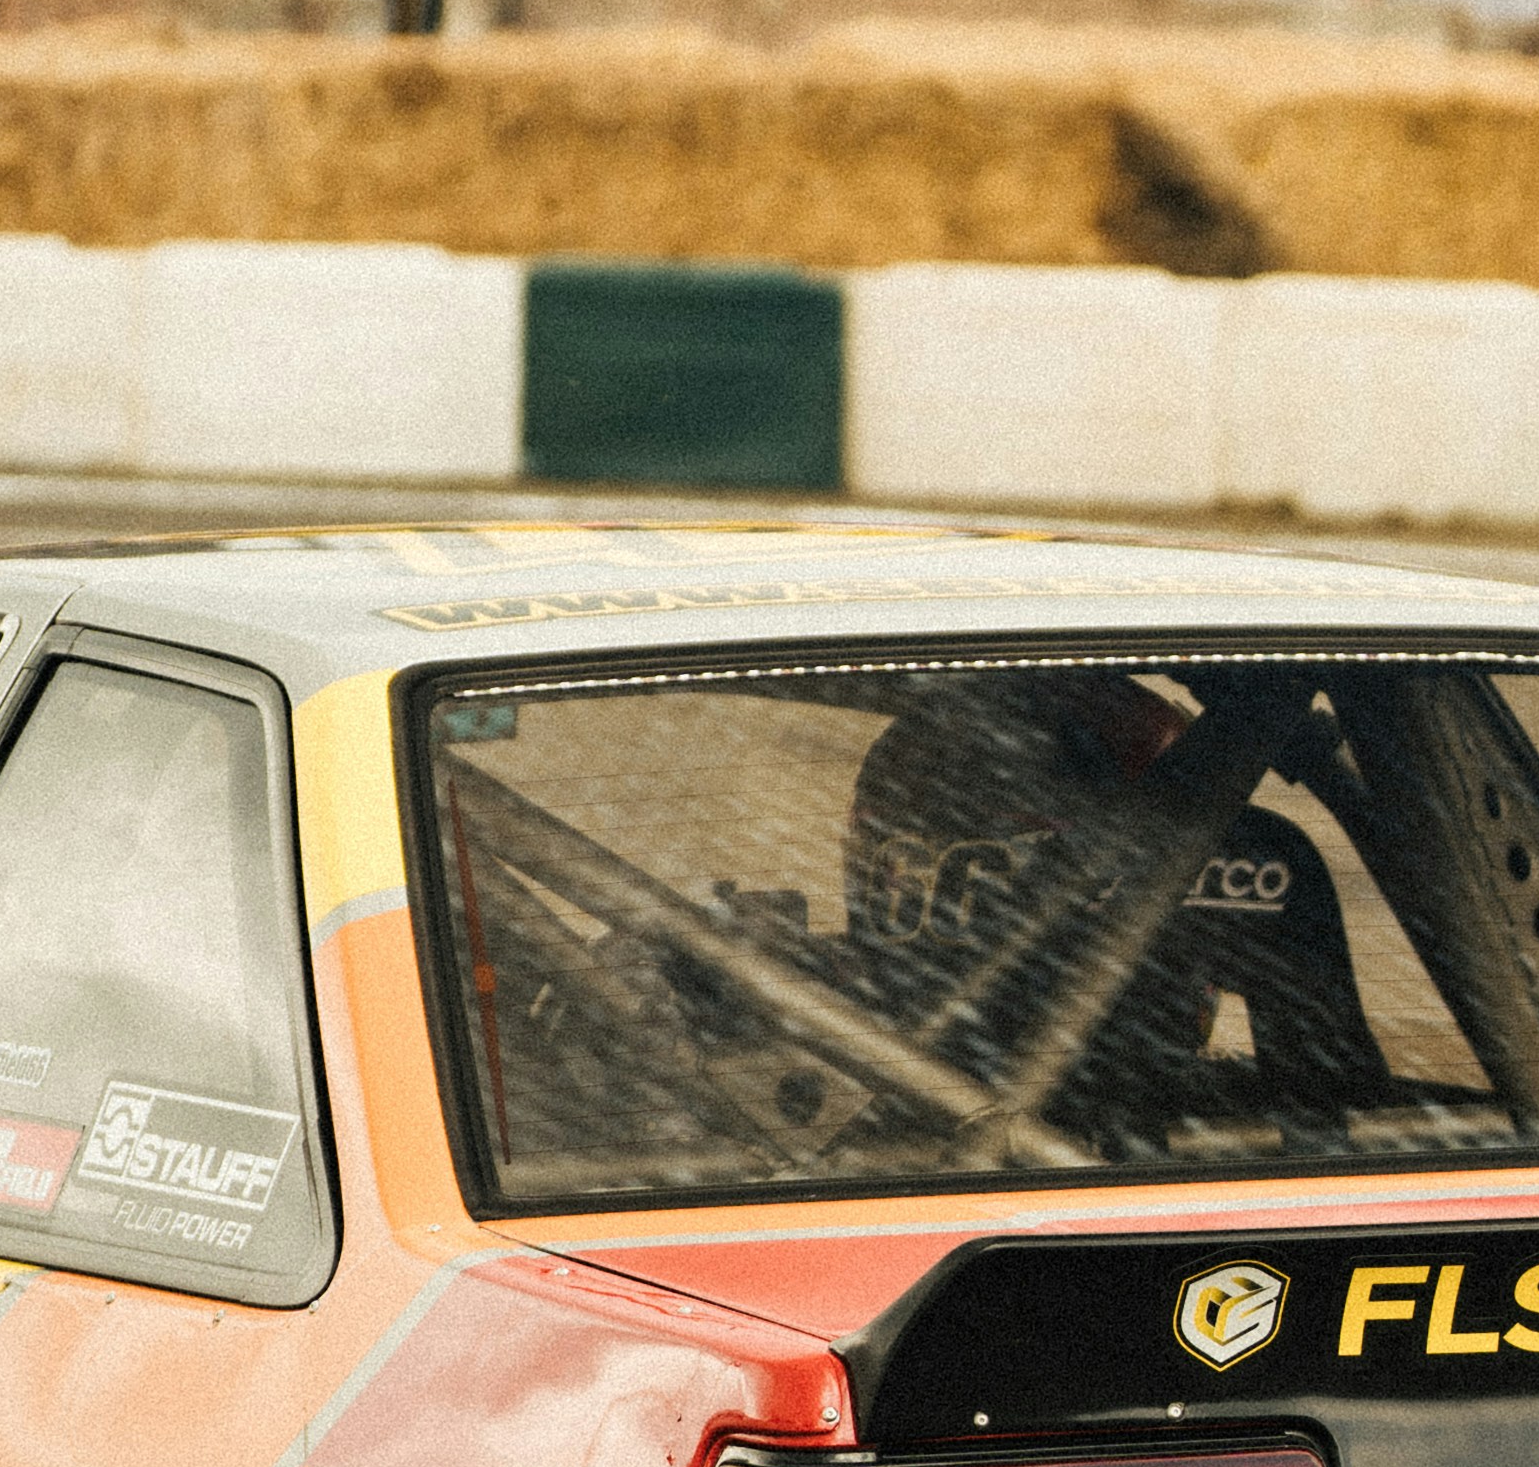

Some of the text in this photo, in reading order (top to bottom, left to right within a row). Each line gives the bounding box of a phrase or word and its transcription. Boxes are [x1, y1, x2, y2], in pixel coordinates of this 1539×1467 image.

[129, 1133, 280, 1199] STAUFF
[113, 1200, 253, 1250] FLUID POWER
